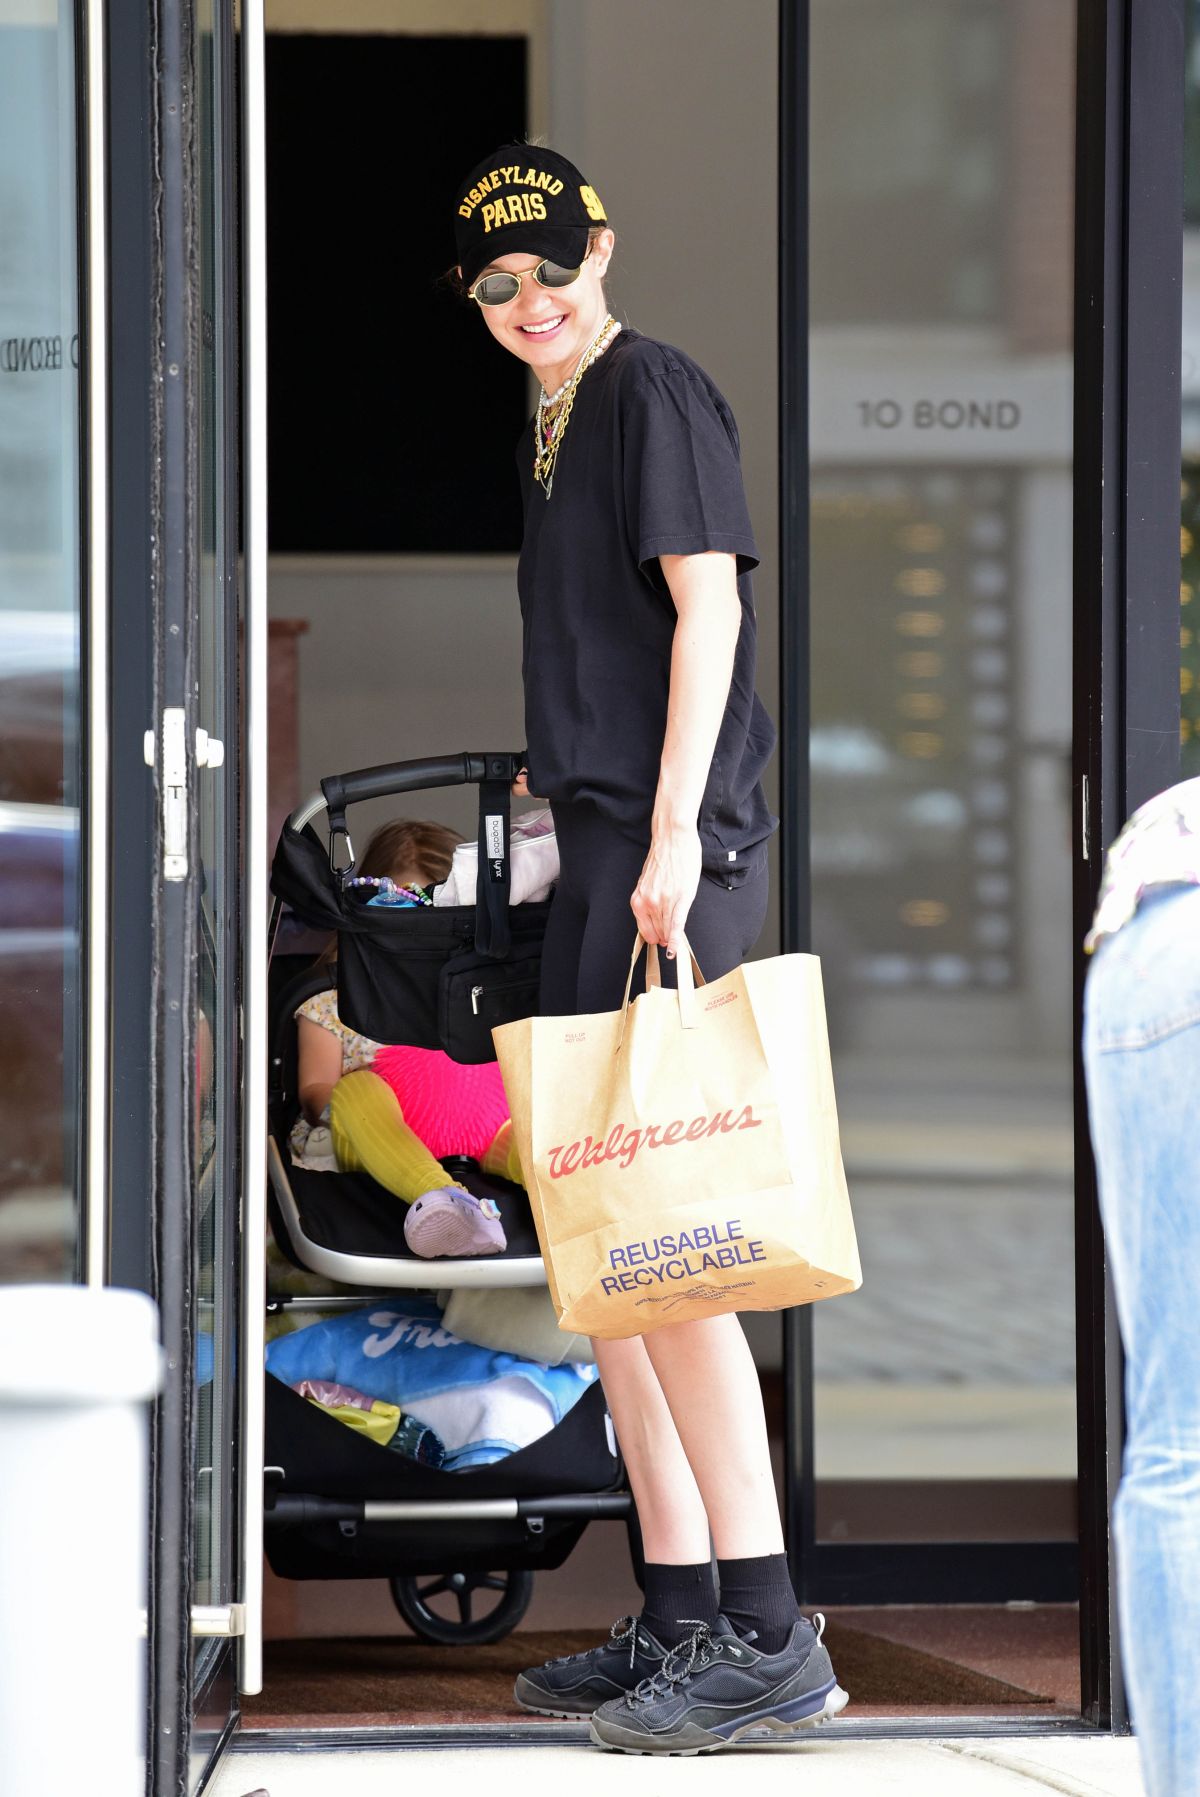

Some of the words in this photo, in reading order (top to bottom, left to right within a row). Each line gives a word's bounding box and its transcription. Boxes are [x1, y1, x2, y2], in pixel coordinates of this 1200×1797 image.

[458, 166, 564, 219] DISNEYLAND
[481, 193, 547, 233] PARIS
[857, 399, 902, 429] 10
[914, 399, 1021, 430] BOND
[493, 860, 502, 878] lynx
[548, 1105, 762, 1179] Walgreens
[600, 1240, 767, 1296] RECYCLABLE
[609, 1219, 745, 1270] REUSABLE
